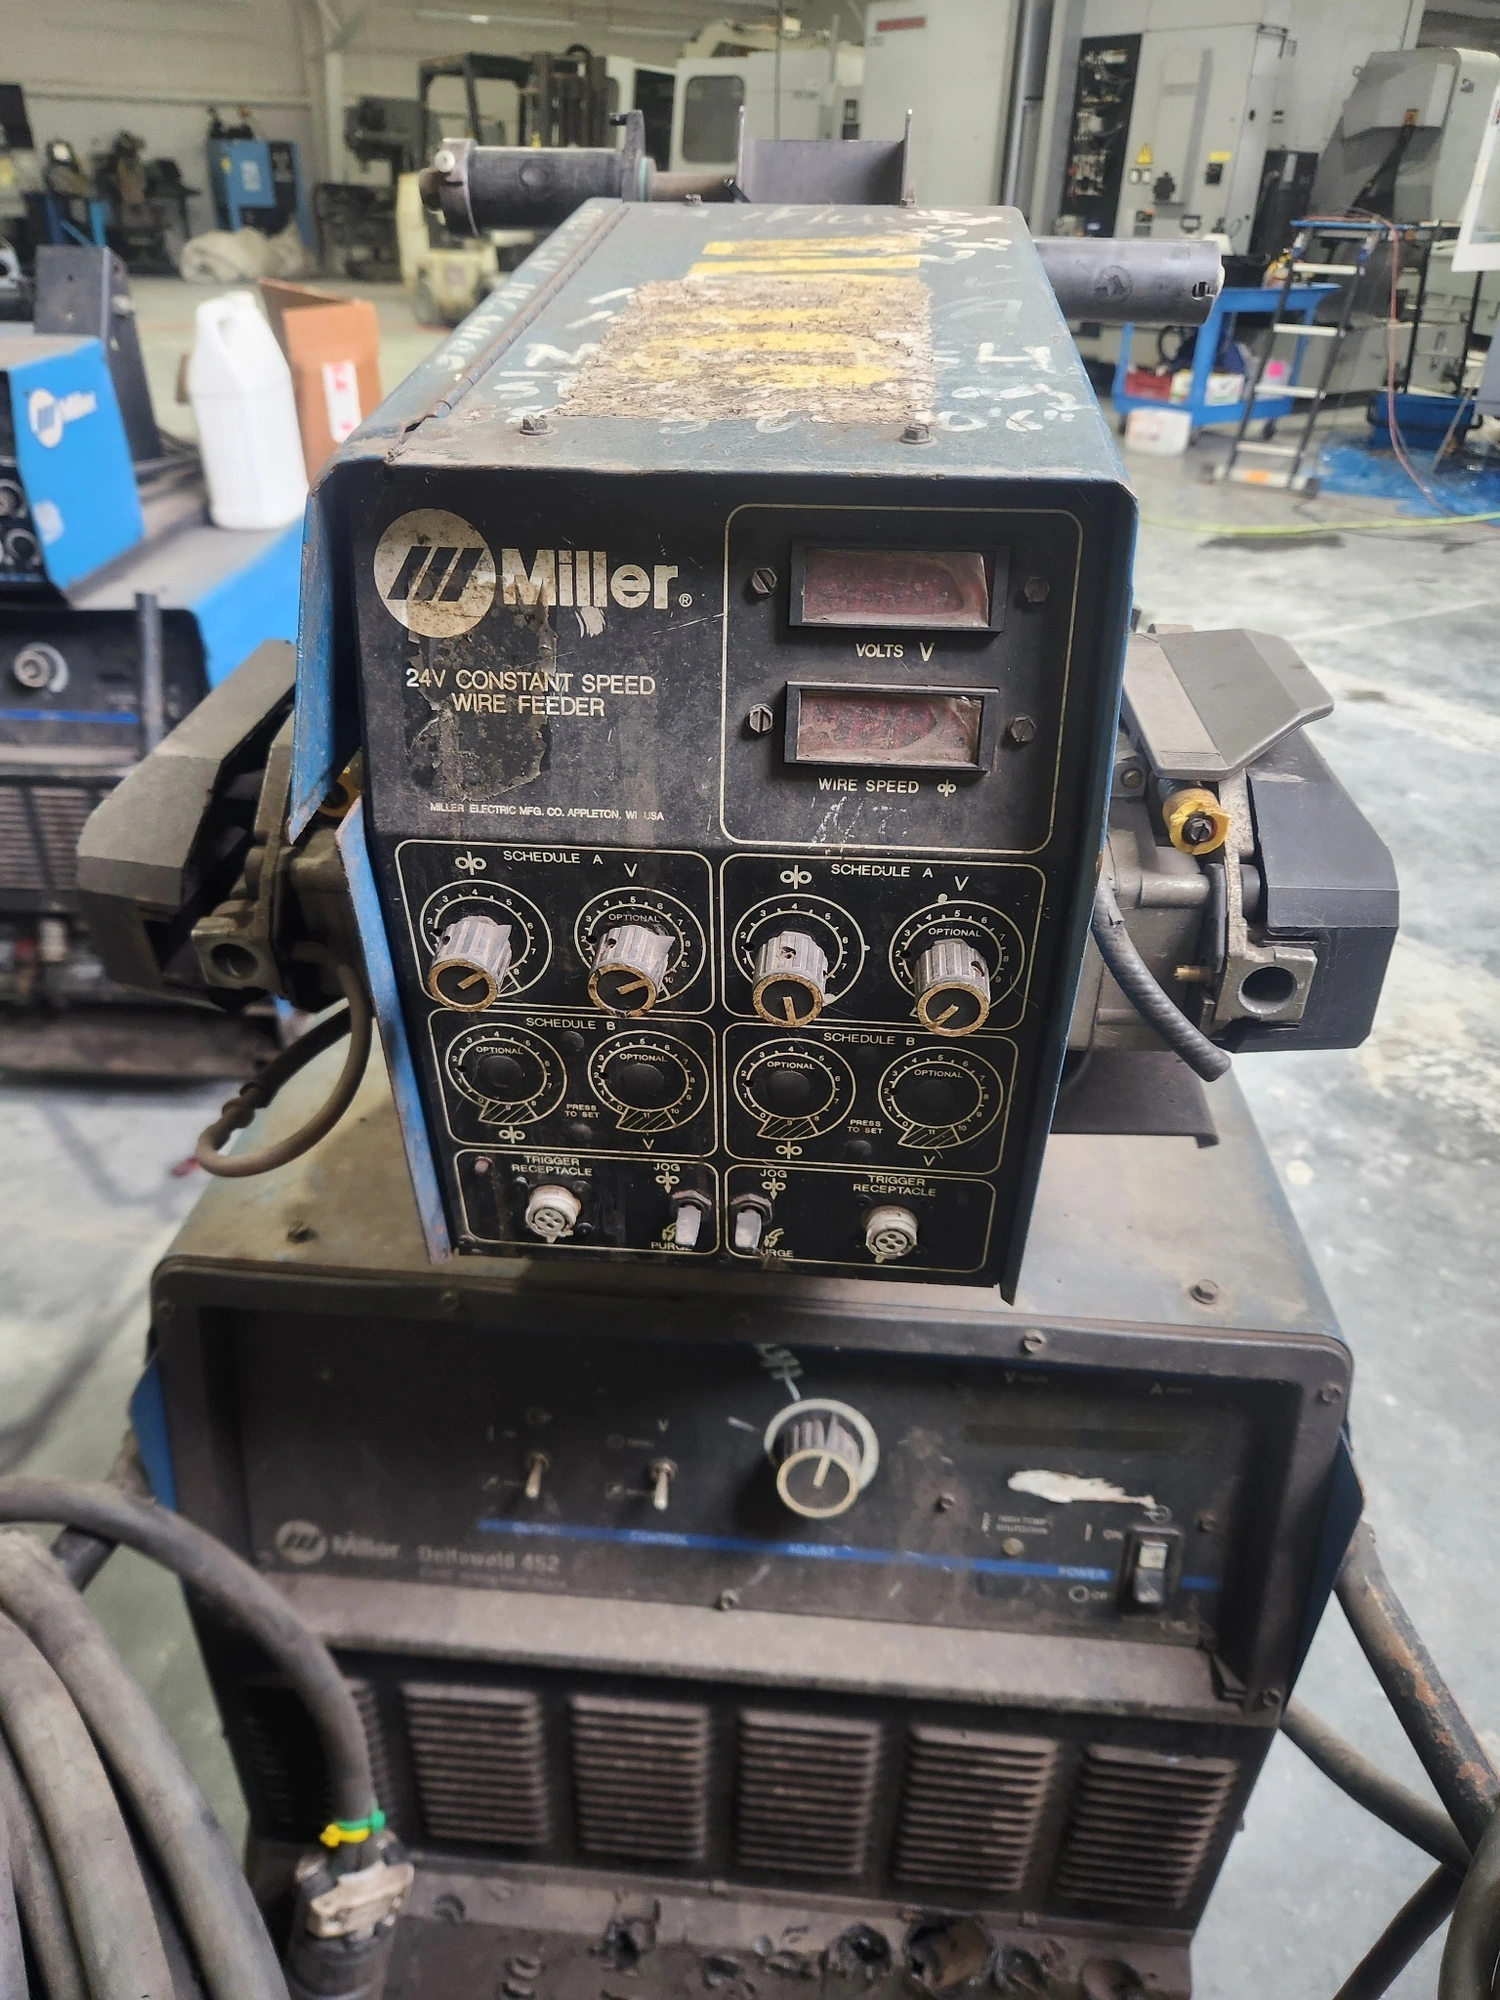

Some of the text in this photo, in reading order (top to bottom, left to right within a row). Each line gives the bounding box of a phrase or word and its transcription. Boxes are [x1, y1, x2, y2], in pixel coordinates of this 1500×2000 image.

[855, 642, 935, 662] VOLTS V
[405, 667, 656, 695] 24V CONSTANT SPEED
[451, 693, 605, 717] WIRE FEEDER
[818, 778, 920, 794] WIRE SPEED
[430, 802, 465, 813] MILLER
[469, 805, 516, 816] ELECTRIC
[519, 806, 545, 817] MFG.
[546, 807, 565, 818] CO.
[625, 810, 638, 820] WI
[643, 811, 665, 821] USA
[503, 850, 604, 865] SCHEDULE A
[623, 862, 638, 878] V
[831, 863, 933, 878] SCHEDULE A
[954, 876, 969, 891] V
[608, 912, 661, 924] OPTIONAL
[928, 927, 982, 938] OPTIONAL
[526, 1017, 616, 1031] SCHEDULE B
[823, 1032, 916, 1046] SCHEDULE B
[475, 1046, 524, 1055] OPTIONAL
[619, 1053, 668, 1062] OPTIONAL
[766, 1060, 815, 1070] OPTIONAL
[913, 1068, 964, 1079] OPTIONAL
[566, 1103, 597, 1111] PRESS
[565, 1110, 600, 1119] TO SET
[850, 1118, 881, 1127] PRESS
[847, 1126, 884, 1135] TO SET
[642, 1139, 654, 1150] V
[524, 1155, 580, 1166] TRIGGER
[923, 1156, 935, 1167] V
[511, 1163, 593, 1176] RECEPTACLE
[653, 1162, 681, 1172] JOG
[760, 1169, 787, 1179] JOG
[867, 1174, 925, 1186] TRIGGER
[852, 1183, 937, 1197] RECEPTACLE
[520, 1553, 561, 1574] 452
